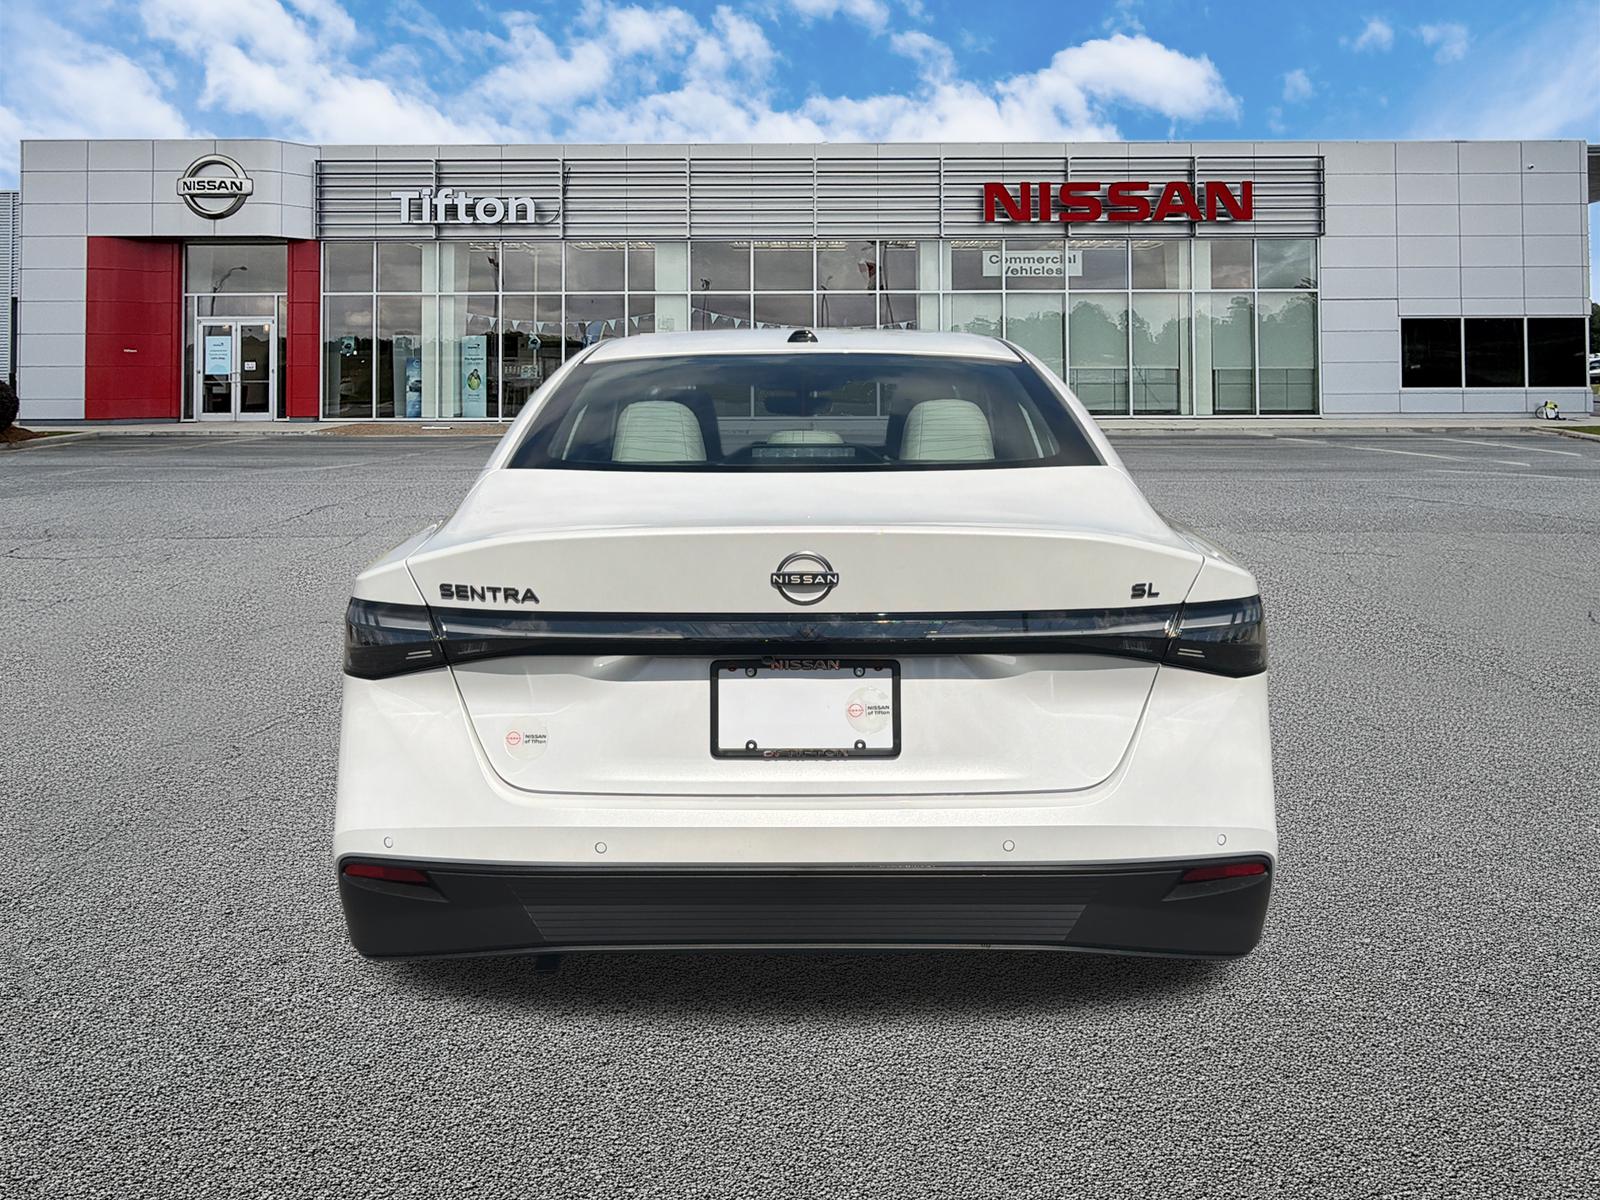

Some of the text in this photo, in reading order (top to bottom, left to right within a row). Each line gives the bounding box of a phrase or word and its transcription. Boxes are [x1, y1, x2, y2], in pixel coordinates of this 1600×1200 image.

[183, 180, 243, 191] NISSAN
[390, 187, 536, 224] Tifton
[983, 181, 1254, 222] NISSAN
[772, 575, 837, 584] NISSAN
[439, 583, 540, 604] SENTRA
[1130, 582, 1160, 599] SL
[769, 659, 840, 670] NISSAN
